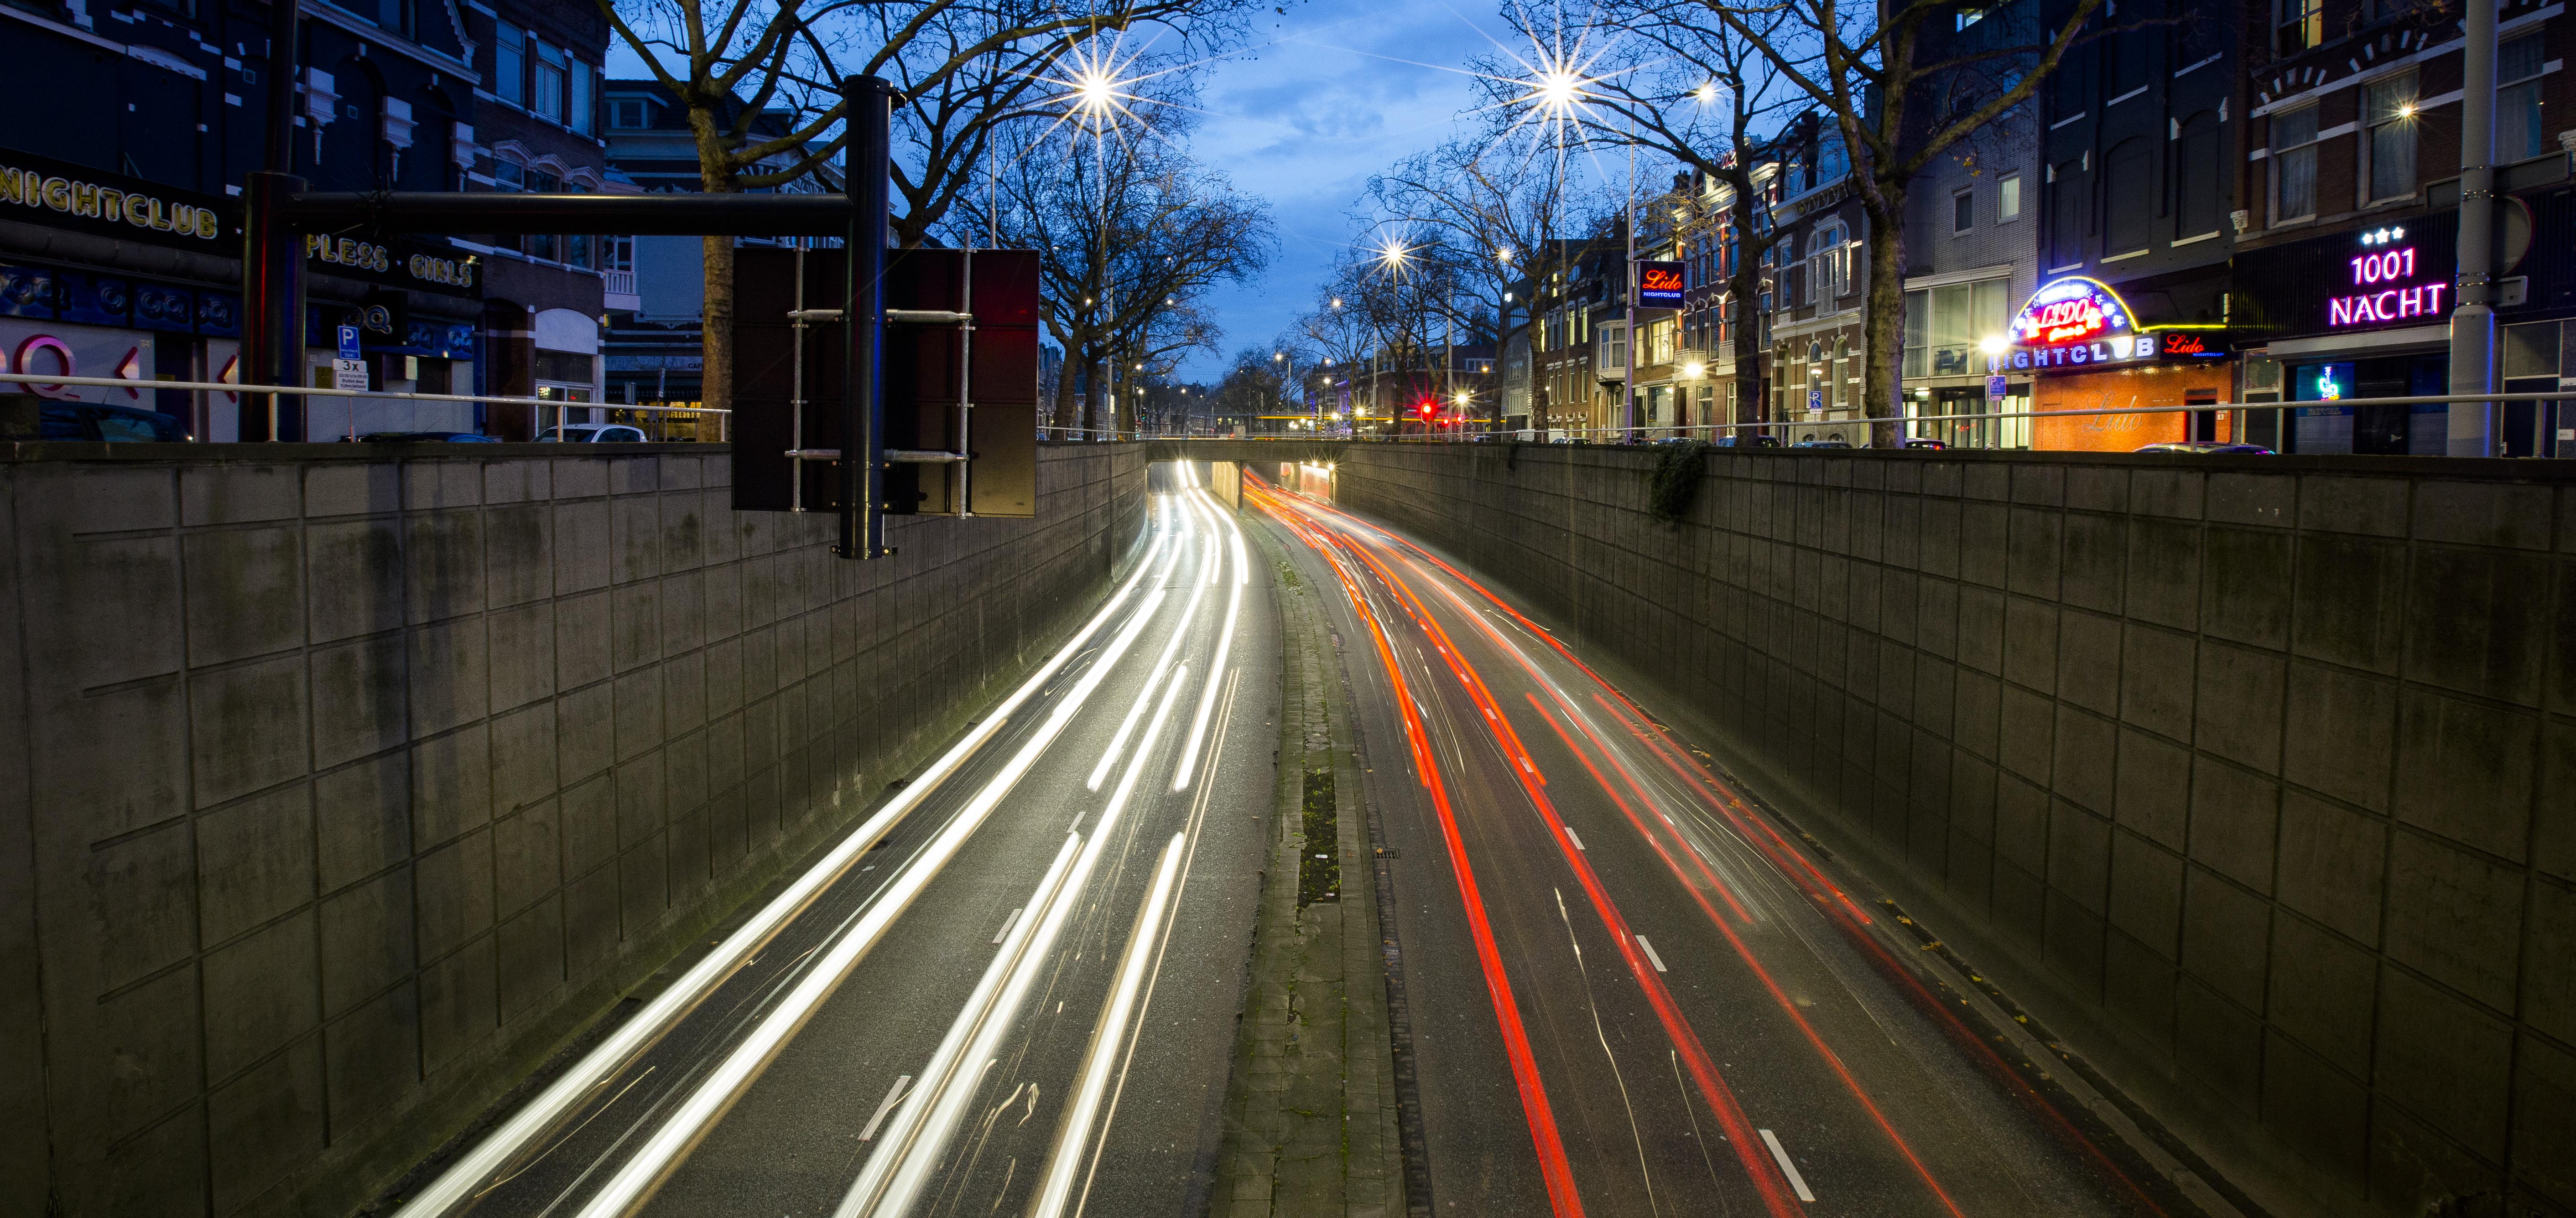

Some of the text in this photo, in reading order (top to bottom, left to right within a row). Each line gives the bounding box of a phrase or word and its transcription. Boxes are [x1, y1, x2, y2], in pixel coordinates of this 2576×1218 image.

[0, 166, 218, 239] NIGHTCLUB
[307, 233, 472, 287] PLESS GIRLS
[2352, 248, 2415, 284] 1001
[1643, 270, 1682, 290] Lido
[2040, 298, 2089, 327] LIDO
[2330, 284, 2447, 325] NACHT
[343, 329, 354, 345] P
[2164, 334, 2205, 353] Lido
[1988, 338, 2154, 371] NIGHTCLUB
[1812, 393, 1819, 402] P
[2083, 390, 2143, 431] Lido
